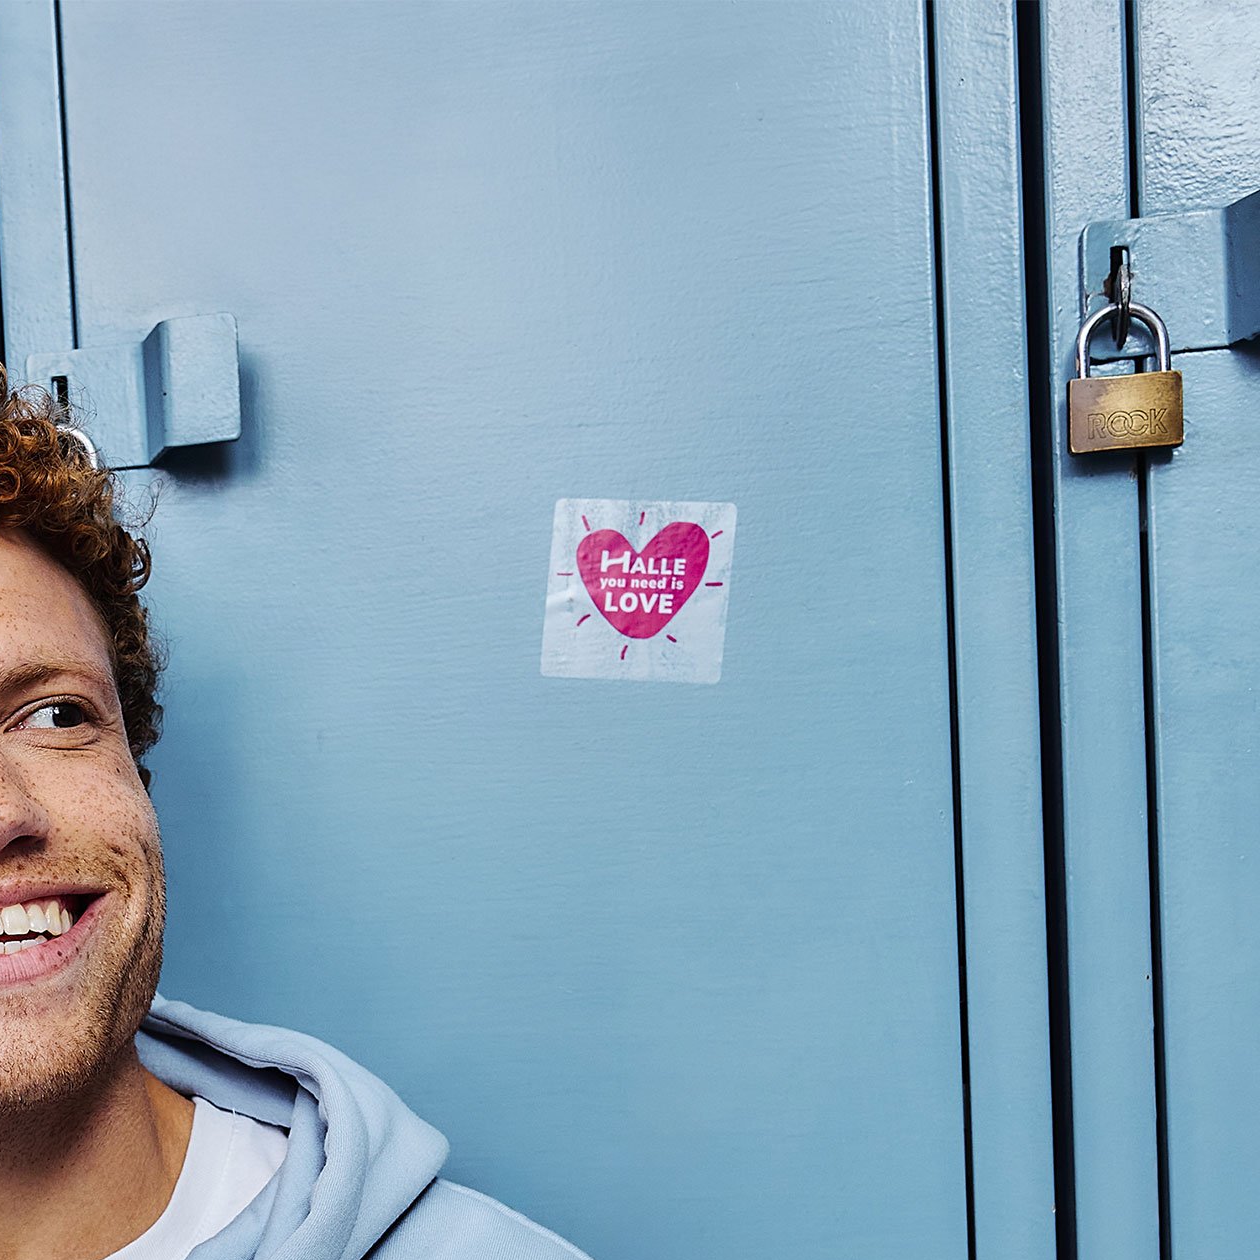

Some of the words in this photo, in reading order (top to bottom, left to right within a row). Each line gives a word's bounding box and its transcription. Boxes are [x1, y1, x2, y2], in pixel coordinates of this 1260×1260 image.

[1087, 407, 1168, 440] ROCK
[600, 550, 687, 576] HALLE
[599, 577, 626, 591] you
[630, 577, 667, 590] need
[670, 577, 685, 590] is
[604, 592, 675, 614] LOVE
